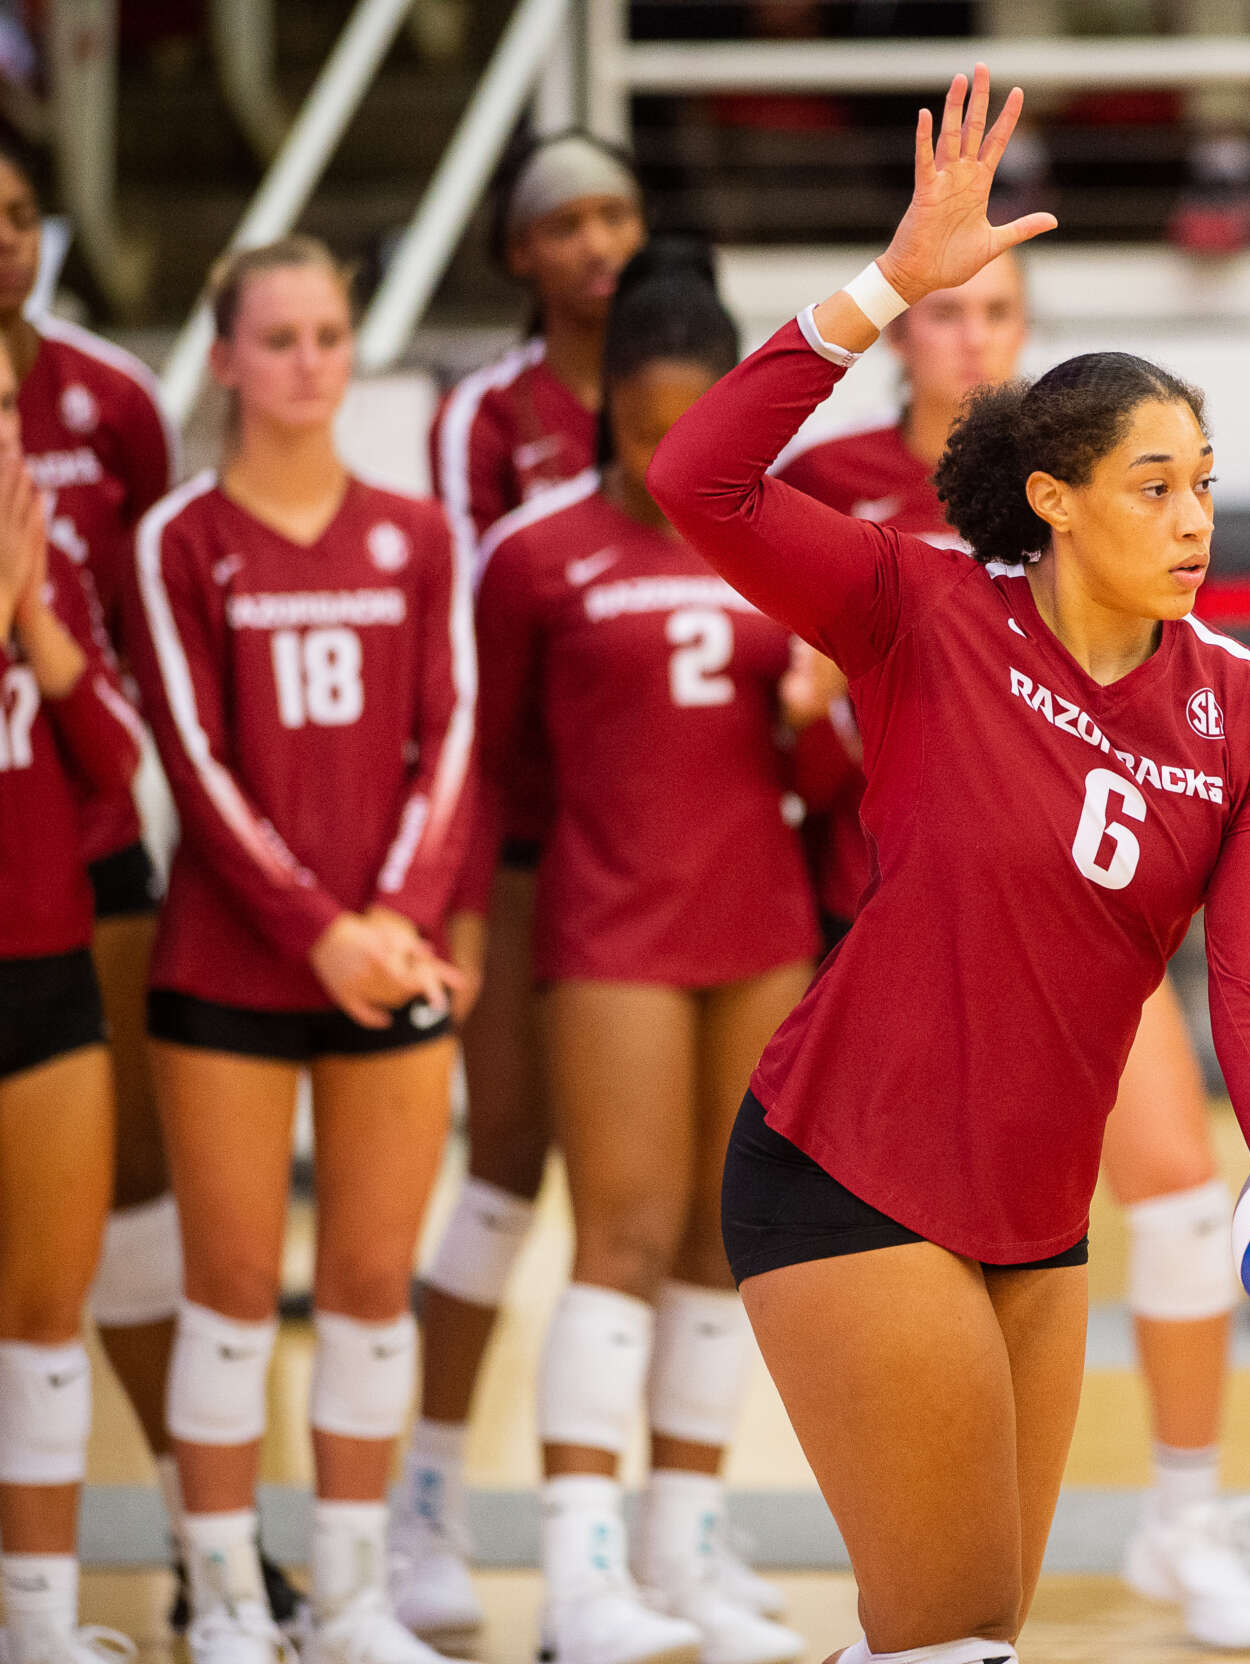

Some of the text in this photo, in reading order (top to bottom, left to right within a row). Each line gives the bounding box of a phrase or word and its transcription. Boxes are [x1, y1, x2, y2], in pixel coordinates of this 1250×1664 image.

[272, 627, 365, 728] 18
[665, 607, 736, 708] 2
[1009, 666, 1223, 805] RAZOACKS
[1072, 767, 1147, 890] 6
